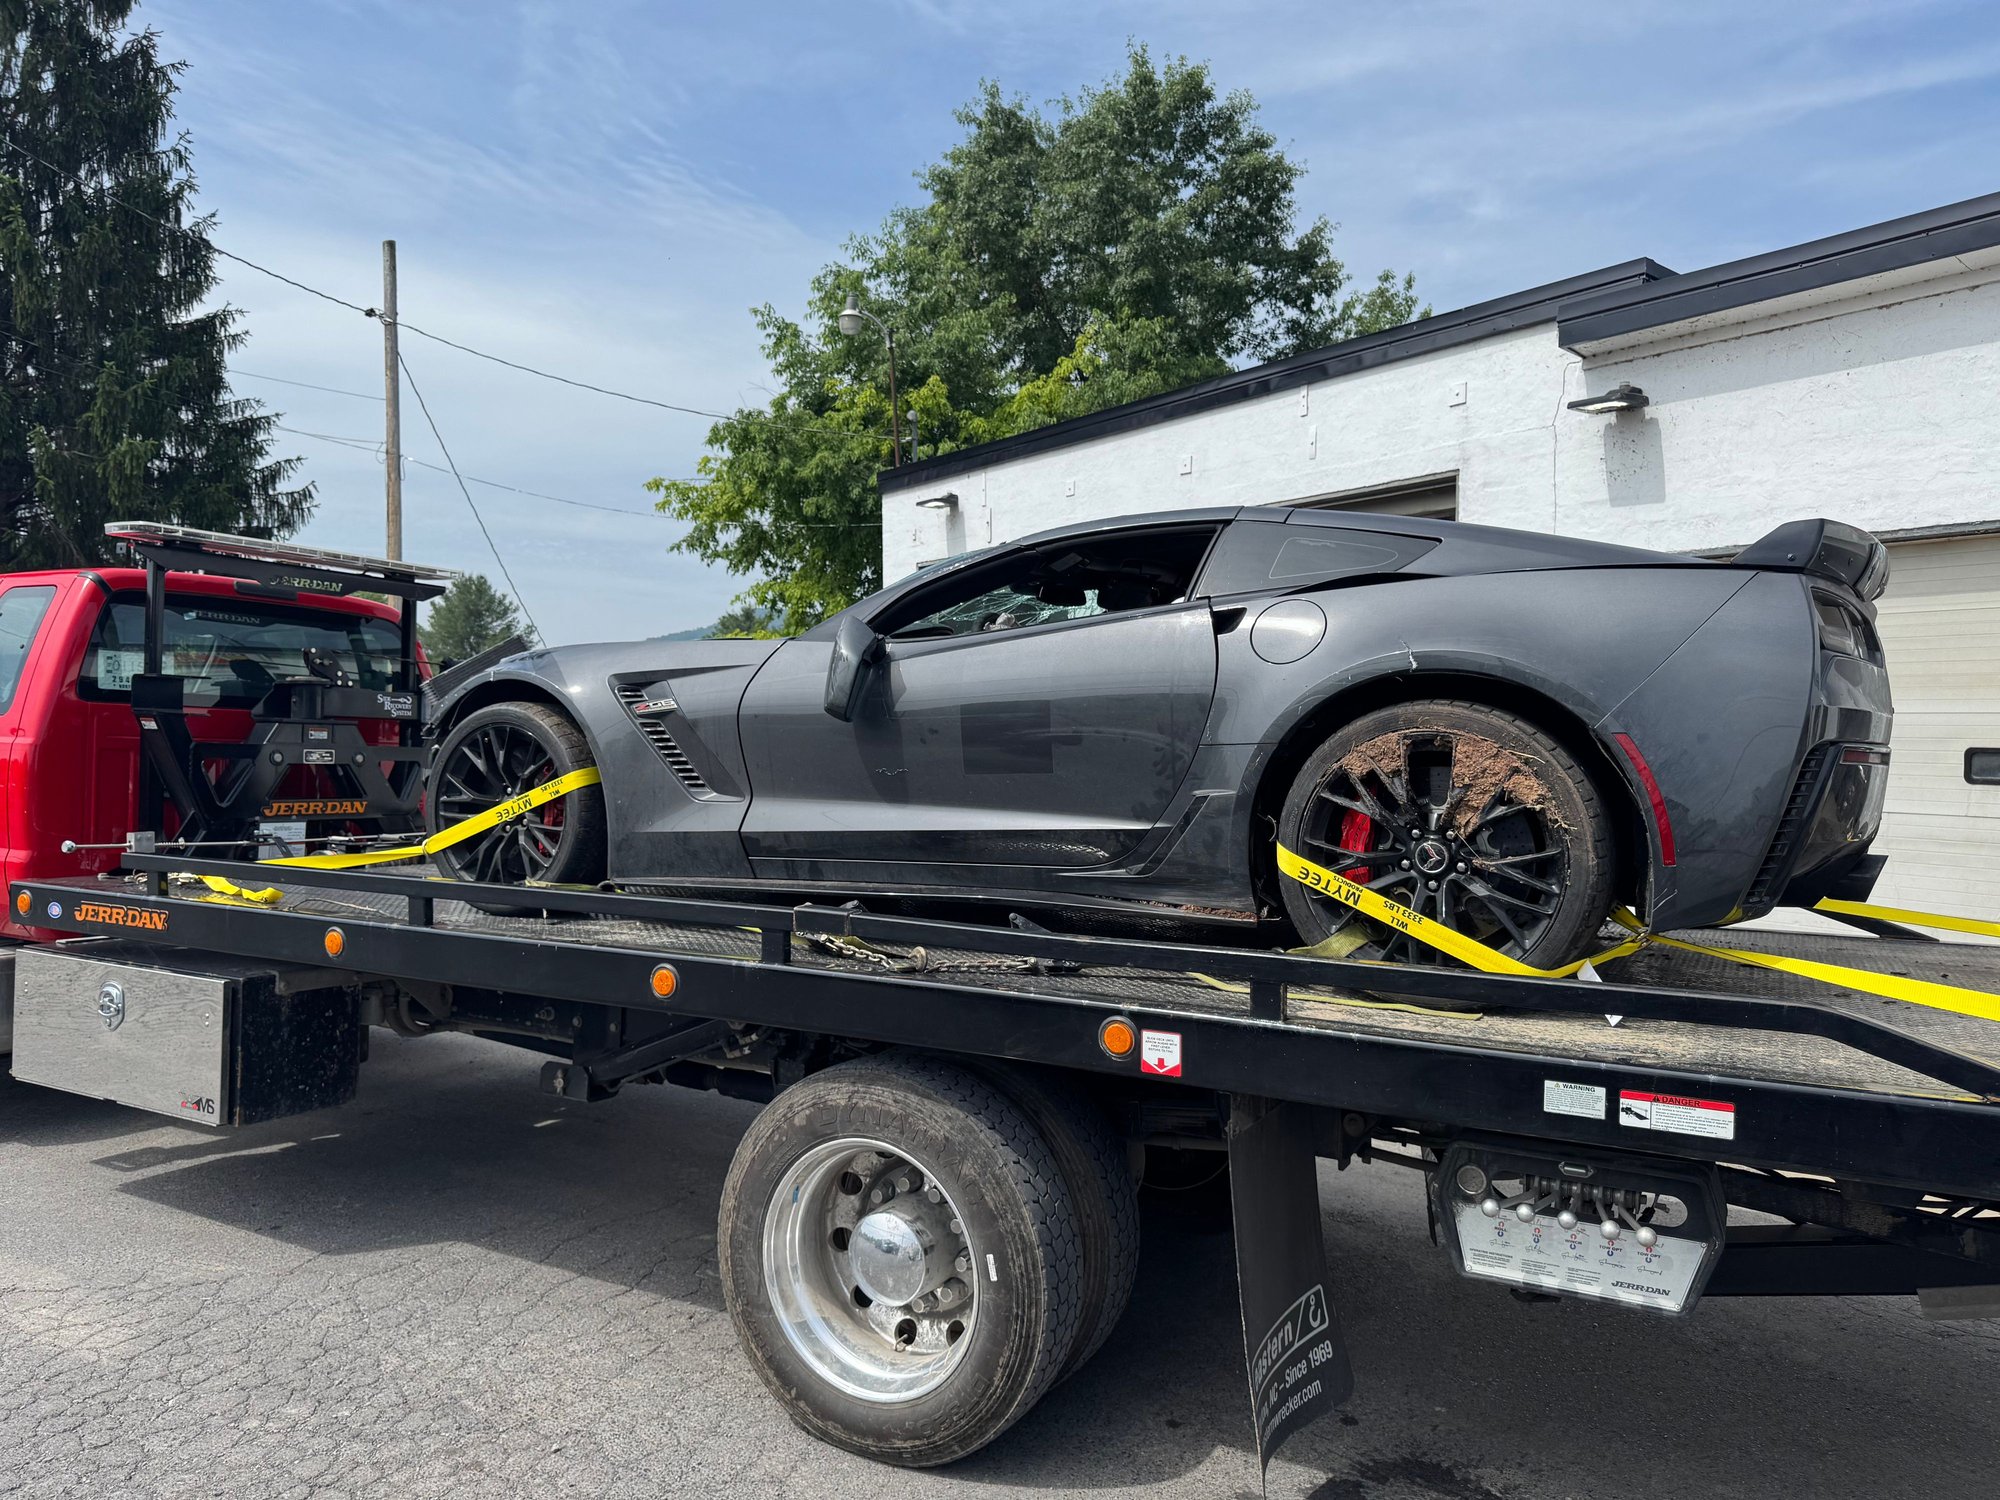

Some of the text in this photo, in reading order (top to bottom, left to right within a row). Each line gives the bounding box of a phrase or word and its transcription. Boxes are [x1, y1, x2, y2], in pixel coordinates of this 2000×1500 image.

[495, 797, 533, 822] MYTEE
[1297, 866, 1361, 907] MYTEE
[1333, 875, 1364, 894] PRODUCTS
[1383, 900, 1425, 925] 3333 LBS
[1390, 915, 1409, 931] WLL
[1562, 1083, 1595, 1093] WARNING
[1662, 1096, 1700, 1107] DANGER
[1269, 1382, 1278, 1408] NC
[1285, 1359, 1308, 1388] Since
[1308, 1339, 1333, 1369] 1969
